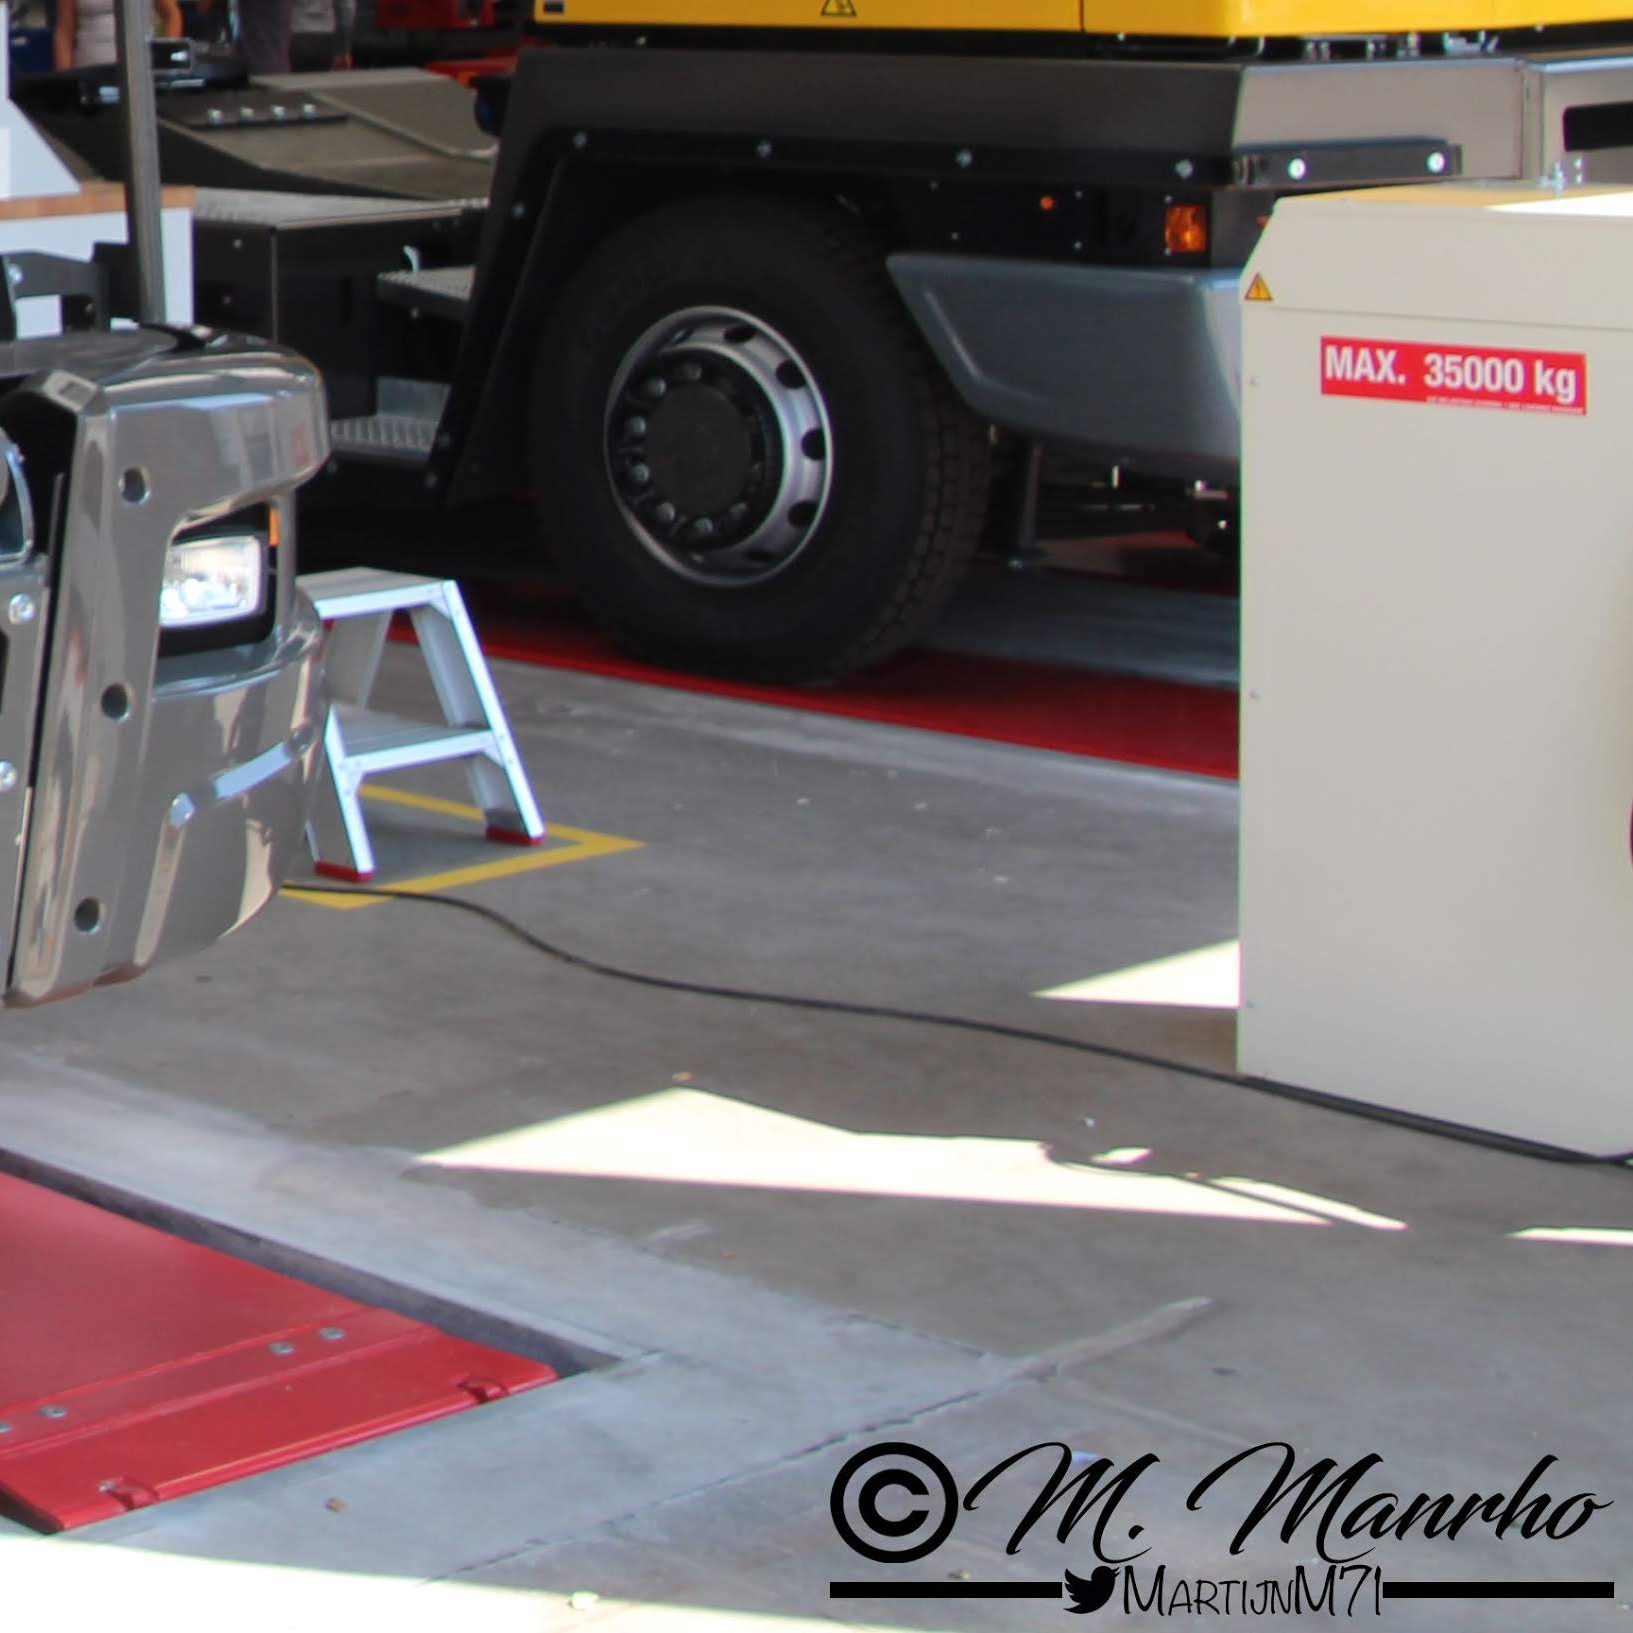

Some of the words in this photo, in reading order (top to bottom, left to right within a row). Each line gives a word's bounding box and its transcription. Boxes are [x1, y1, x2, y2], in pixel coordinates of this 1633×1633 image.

[1324, 344, 1407, 386] MAX.
[1423, 352, 1525, 395] 35000
[1534, 359, 1577, 406] kg
